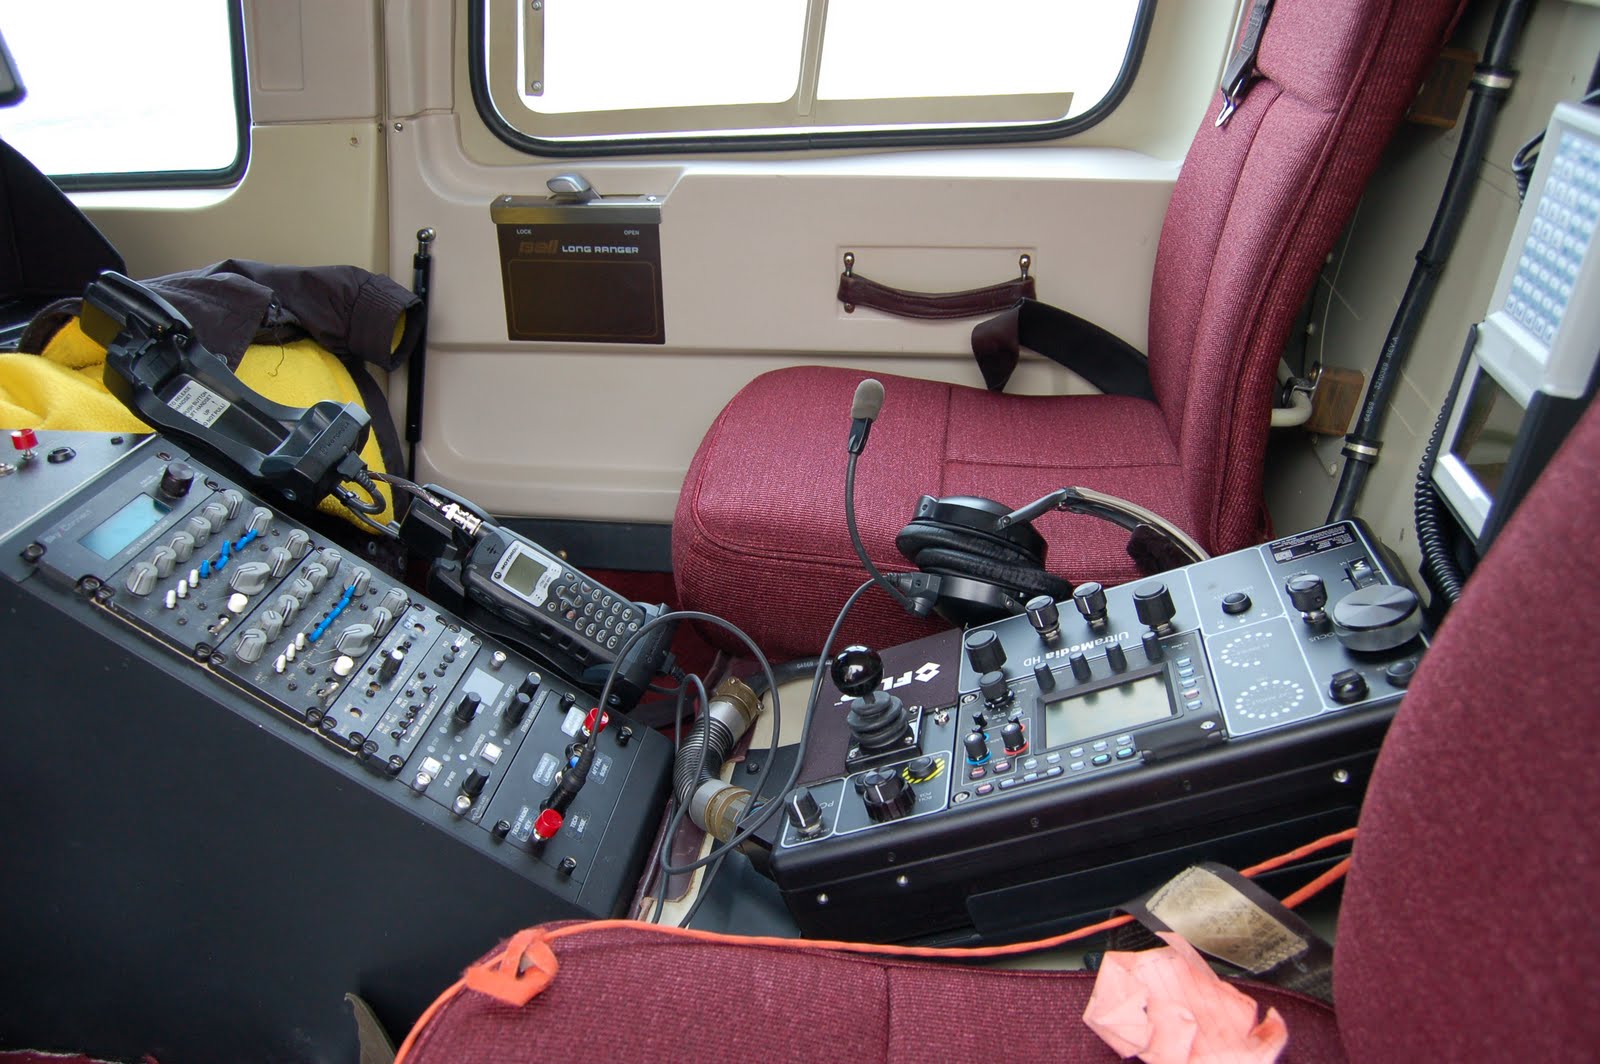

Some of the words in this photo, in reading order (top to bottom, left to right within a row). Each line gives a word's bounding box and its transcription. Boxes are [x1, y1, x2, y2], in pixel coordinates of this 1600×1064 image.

[562, 245, 592, 253] LONG
[594, 246, 639, 254] RANGER
[174, 386, 191, 402] RELEASE
[192, 390, 207, 406] BUTTON
[196, 394, 212, 411] HANDSET
[1309, 632, 1336, 642] OCUS
[1045, 632, 1129, 660] UltraMedia
[1023, 656, 1040, 667] HD
[518, 806, 528, 822] RADIO
[569, 814, 578, 828] TECH
[576, 818, 586, 832] BOSE
